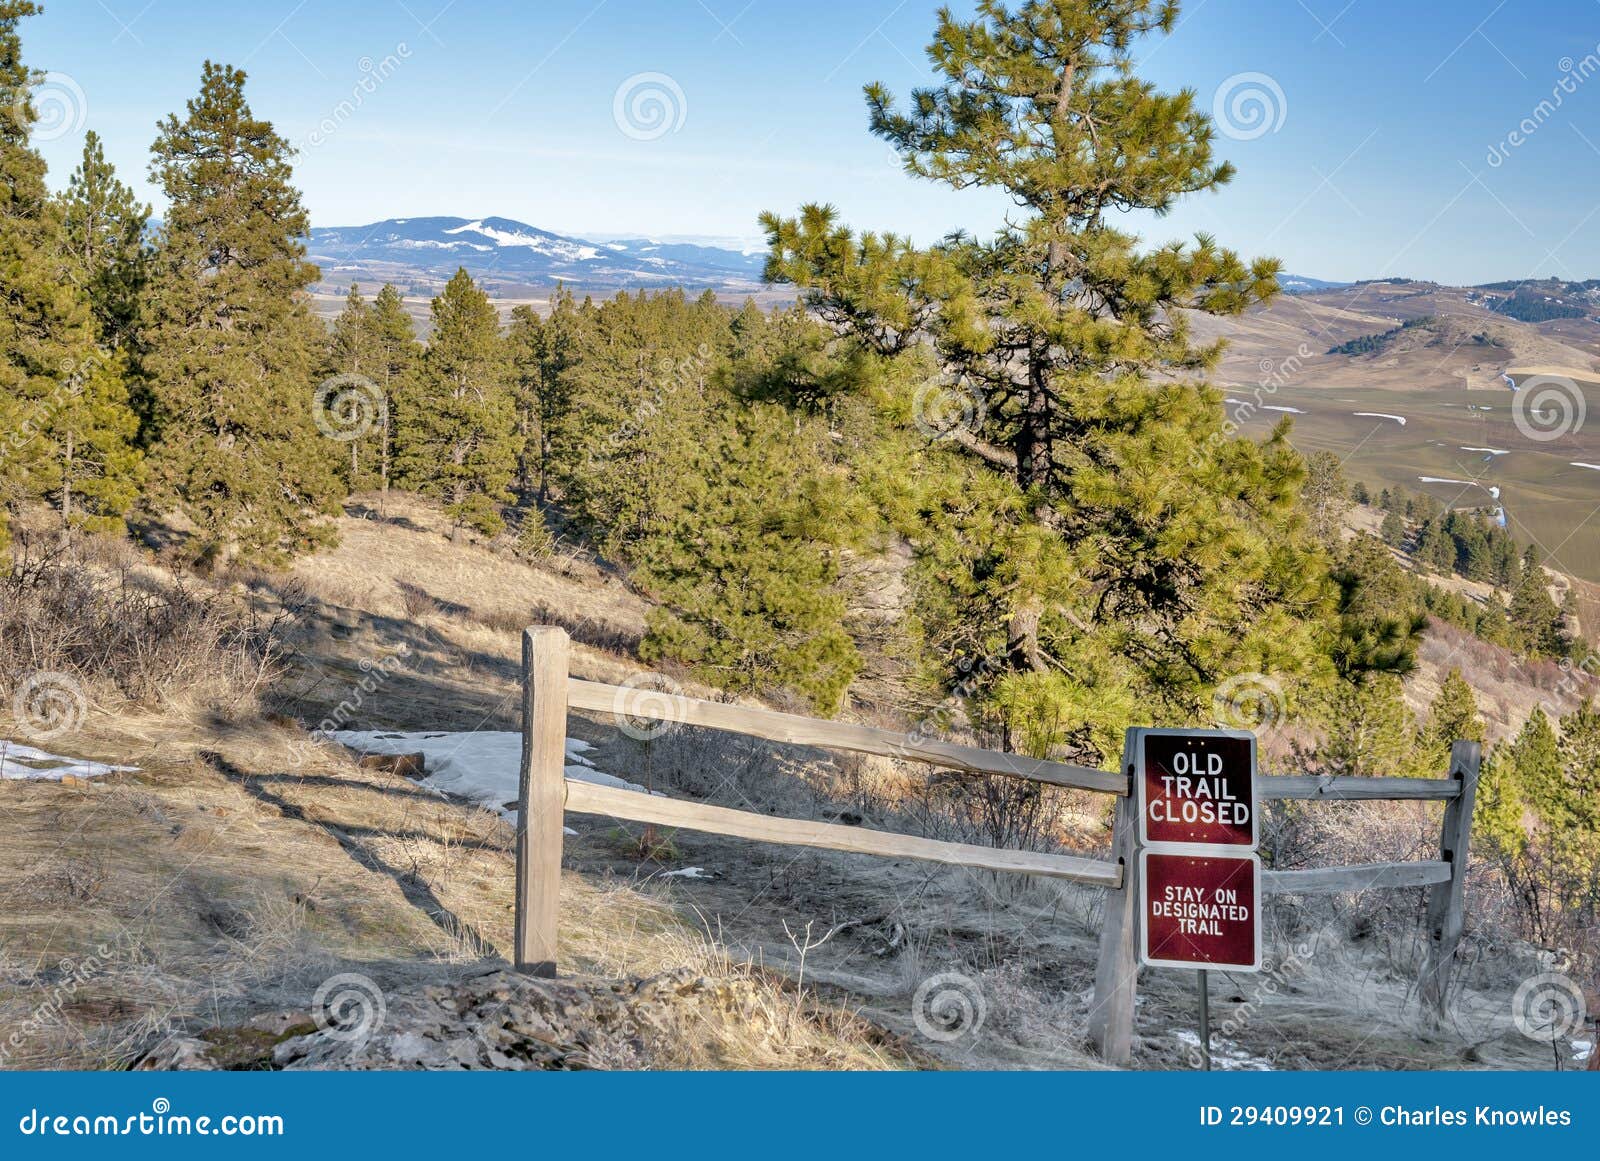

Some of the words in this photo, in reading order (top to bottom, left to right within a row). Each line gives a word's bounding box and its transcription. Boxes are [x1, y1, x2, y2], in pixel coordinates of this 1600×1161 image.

[1173, 752, 1223, 775] OLD
[1161, 776, 1237, 800] TRAIL
[1149, 800, 1250, 825] CLOSED
[1165, 886, 1205, 902] STAY
[1215, 888, 1237, 905] ON
[1152, 902, 1249, 921] DESIGNATED
[1178, 918, 1223, 936] TRAIL
